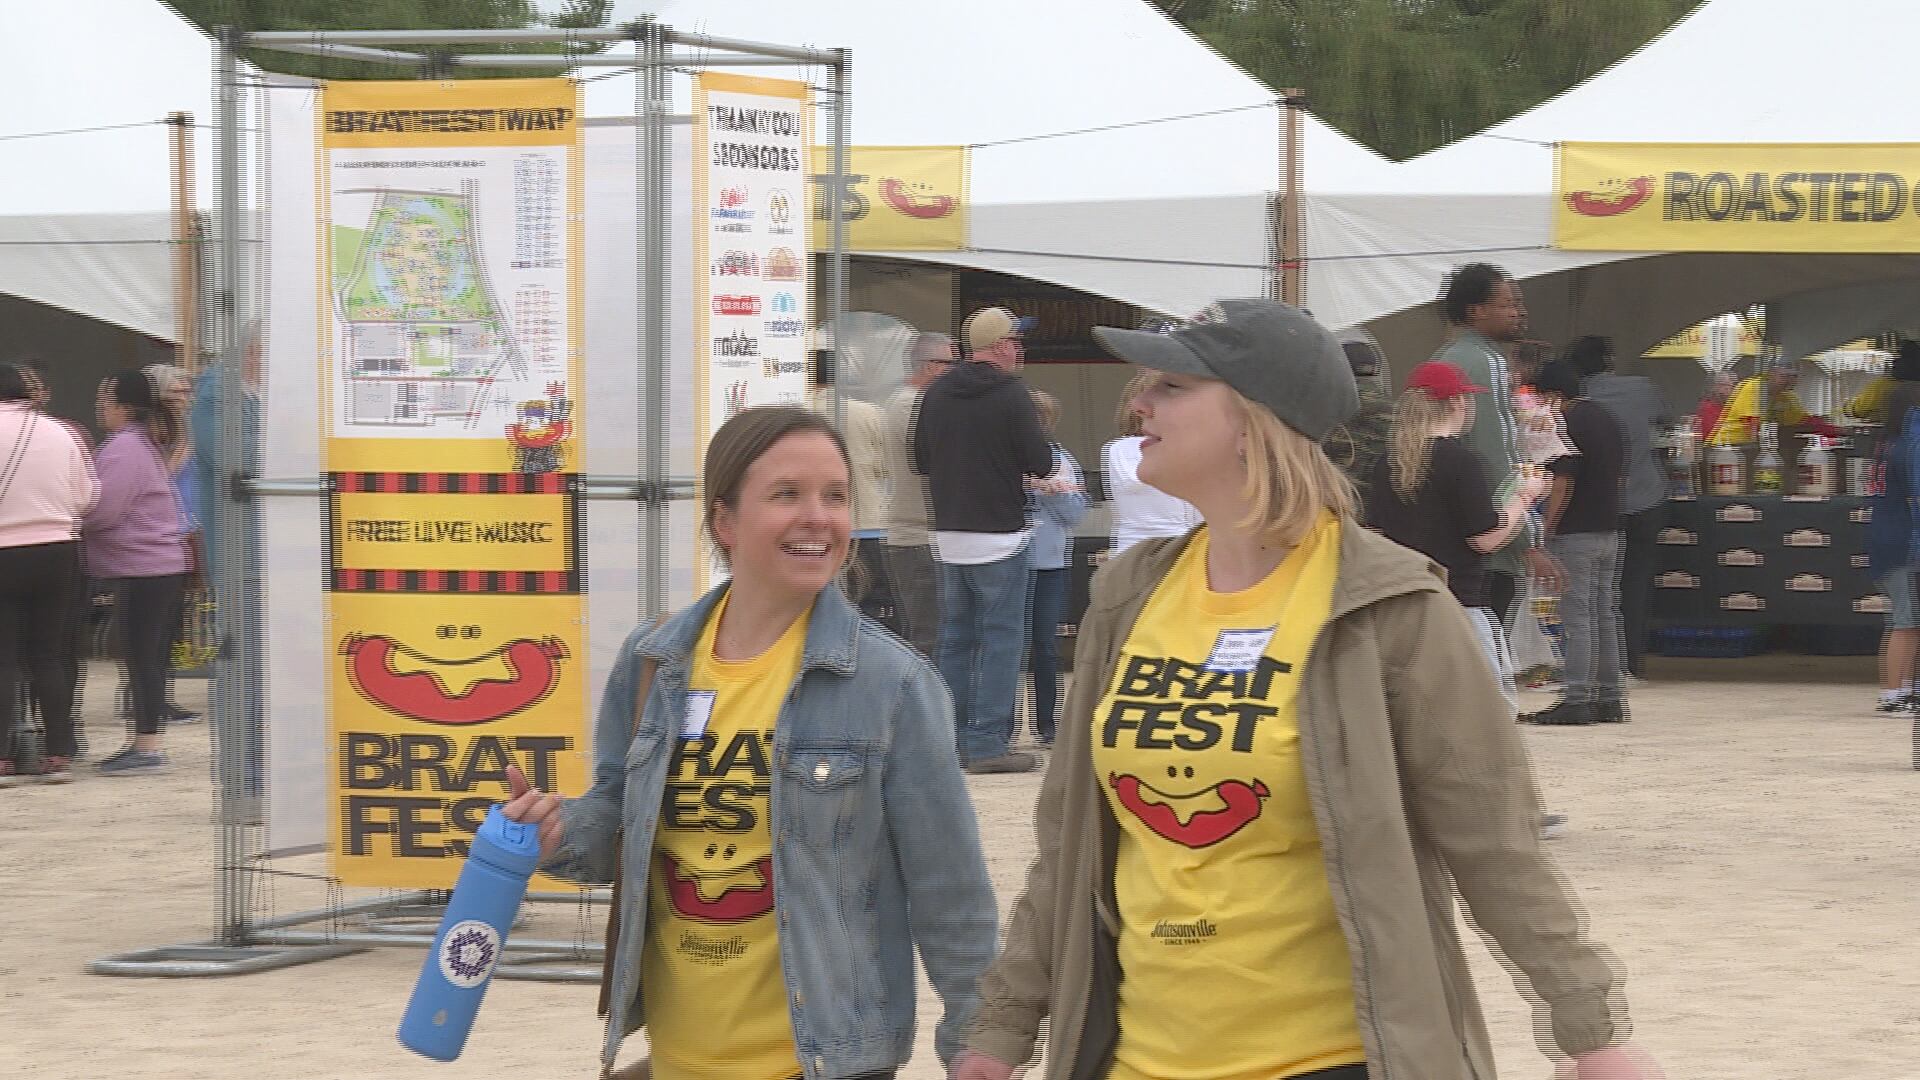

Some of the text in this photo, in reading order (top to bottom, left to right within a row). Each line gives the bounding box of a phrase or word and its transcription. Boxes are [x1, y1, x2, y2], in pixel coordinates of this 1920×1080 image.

[499, 107, 573, 131] MAP
[707, 104, 800, 138] THANK YOU
[713, 141, 800, 173] SPONSORS
[1662, 170, 1910, 223] ROASTED
[346, 519, 554, 546] FREE LIVE MUSIC
[1117, 656, 1293, 700] BRAT
[1102, 701, 1279, 753] FEST
[340, 731, 575, 794] BRAT
[667, 728, 777, 778] RA
[341, 794, 500, 860] FES
[659, 780, 774, 833] ES
[1150, 918, 1218, 939] Johnsonville
